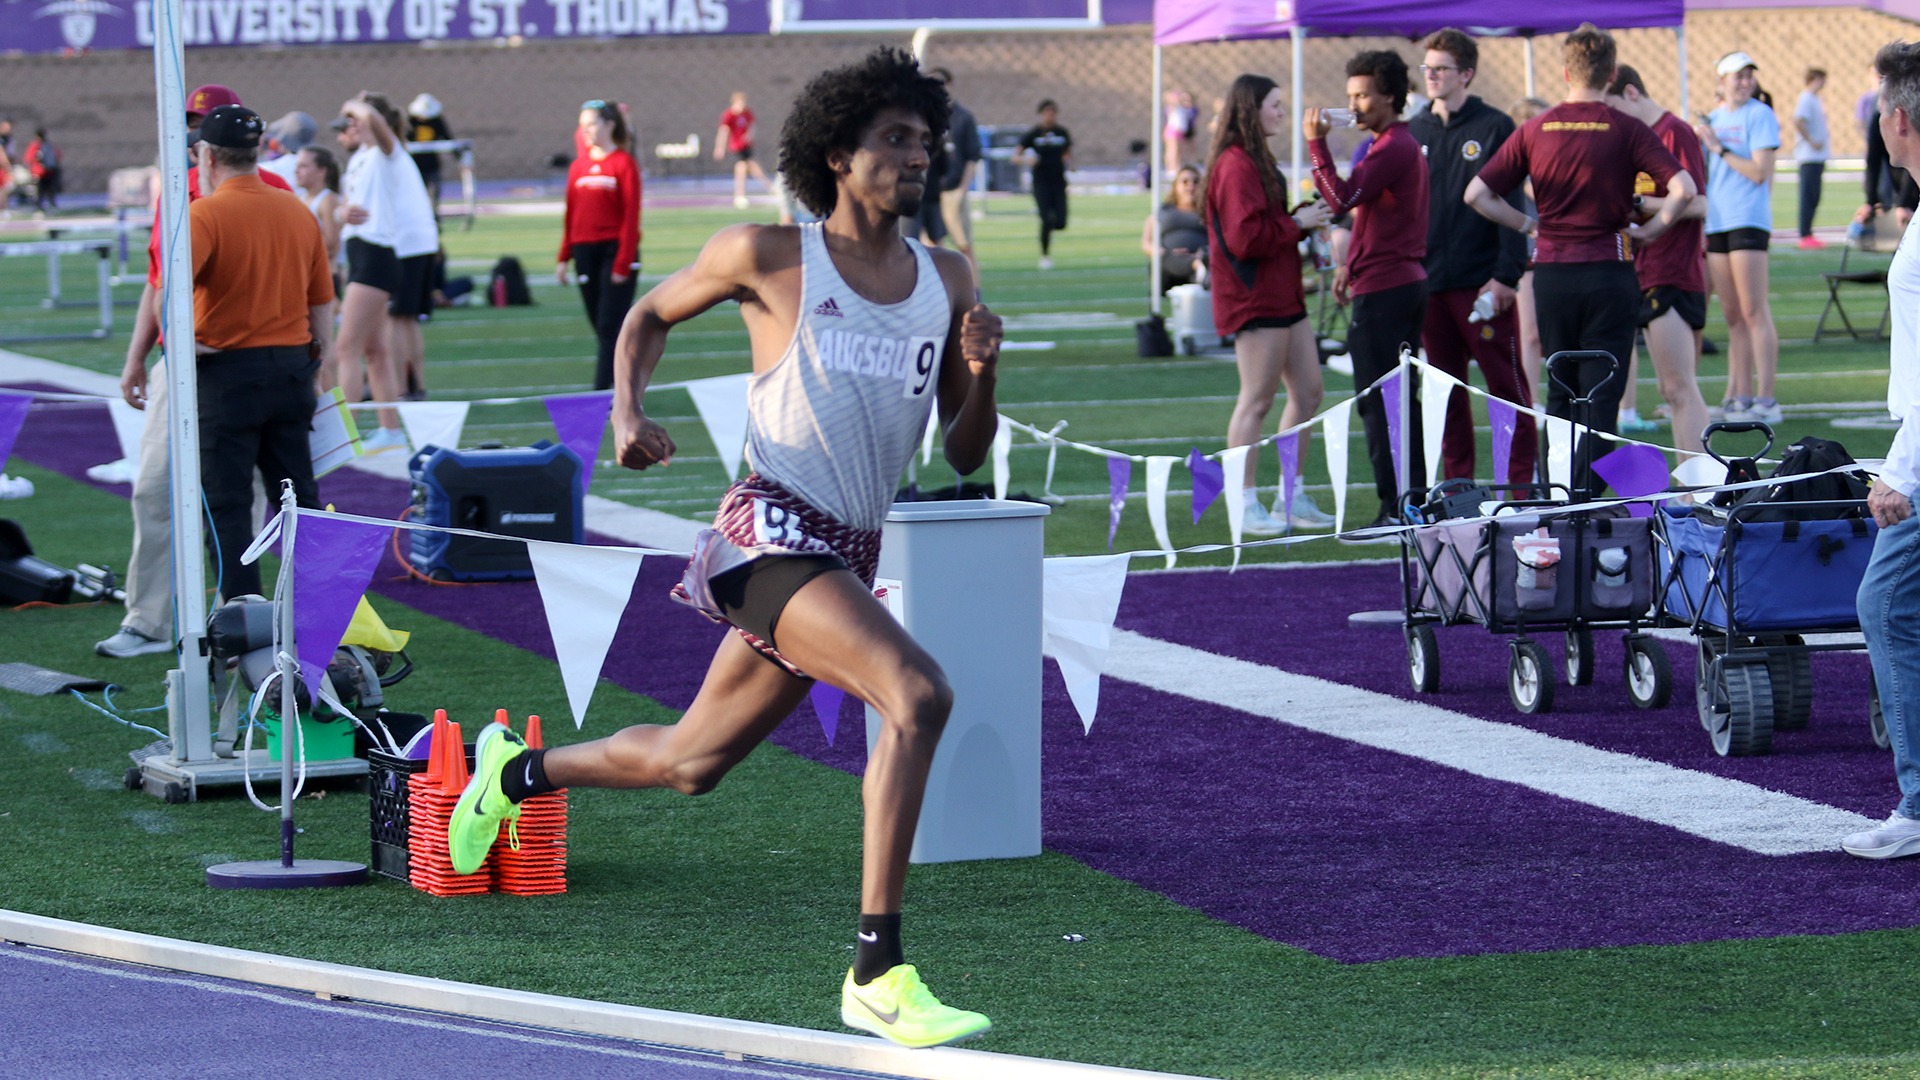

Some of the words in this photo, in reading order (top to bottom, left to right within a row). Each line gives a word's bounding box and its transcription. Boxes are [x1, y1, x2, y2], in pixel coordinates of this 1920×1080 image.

[403, 0, 456, 38] OF
[469, 0, 538, 36] ST.
[549, 0, 728, 34] THOMAS
[913, 340, 935, 395] 9
